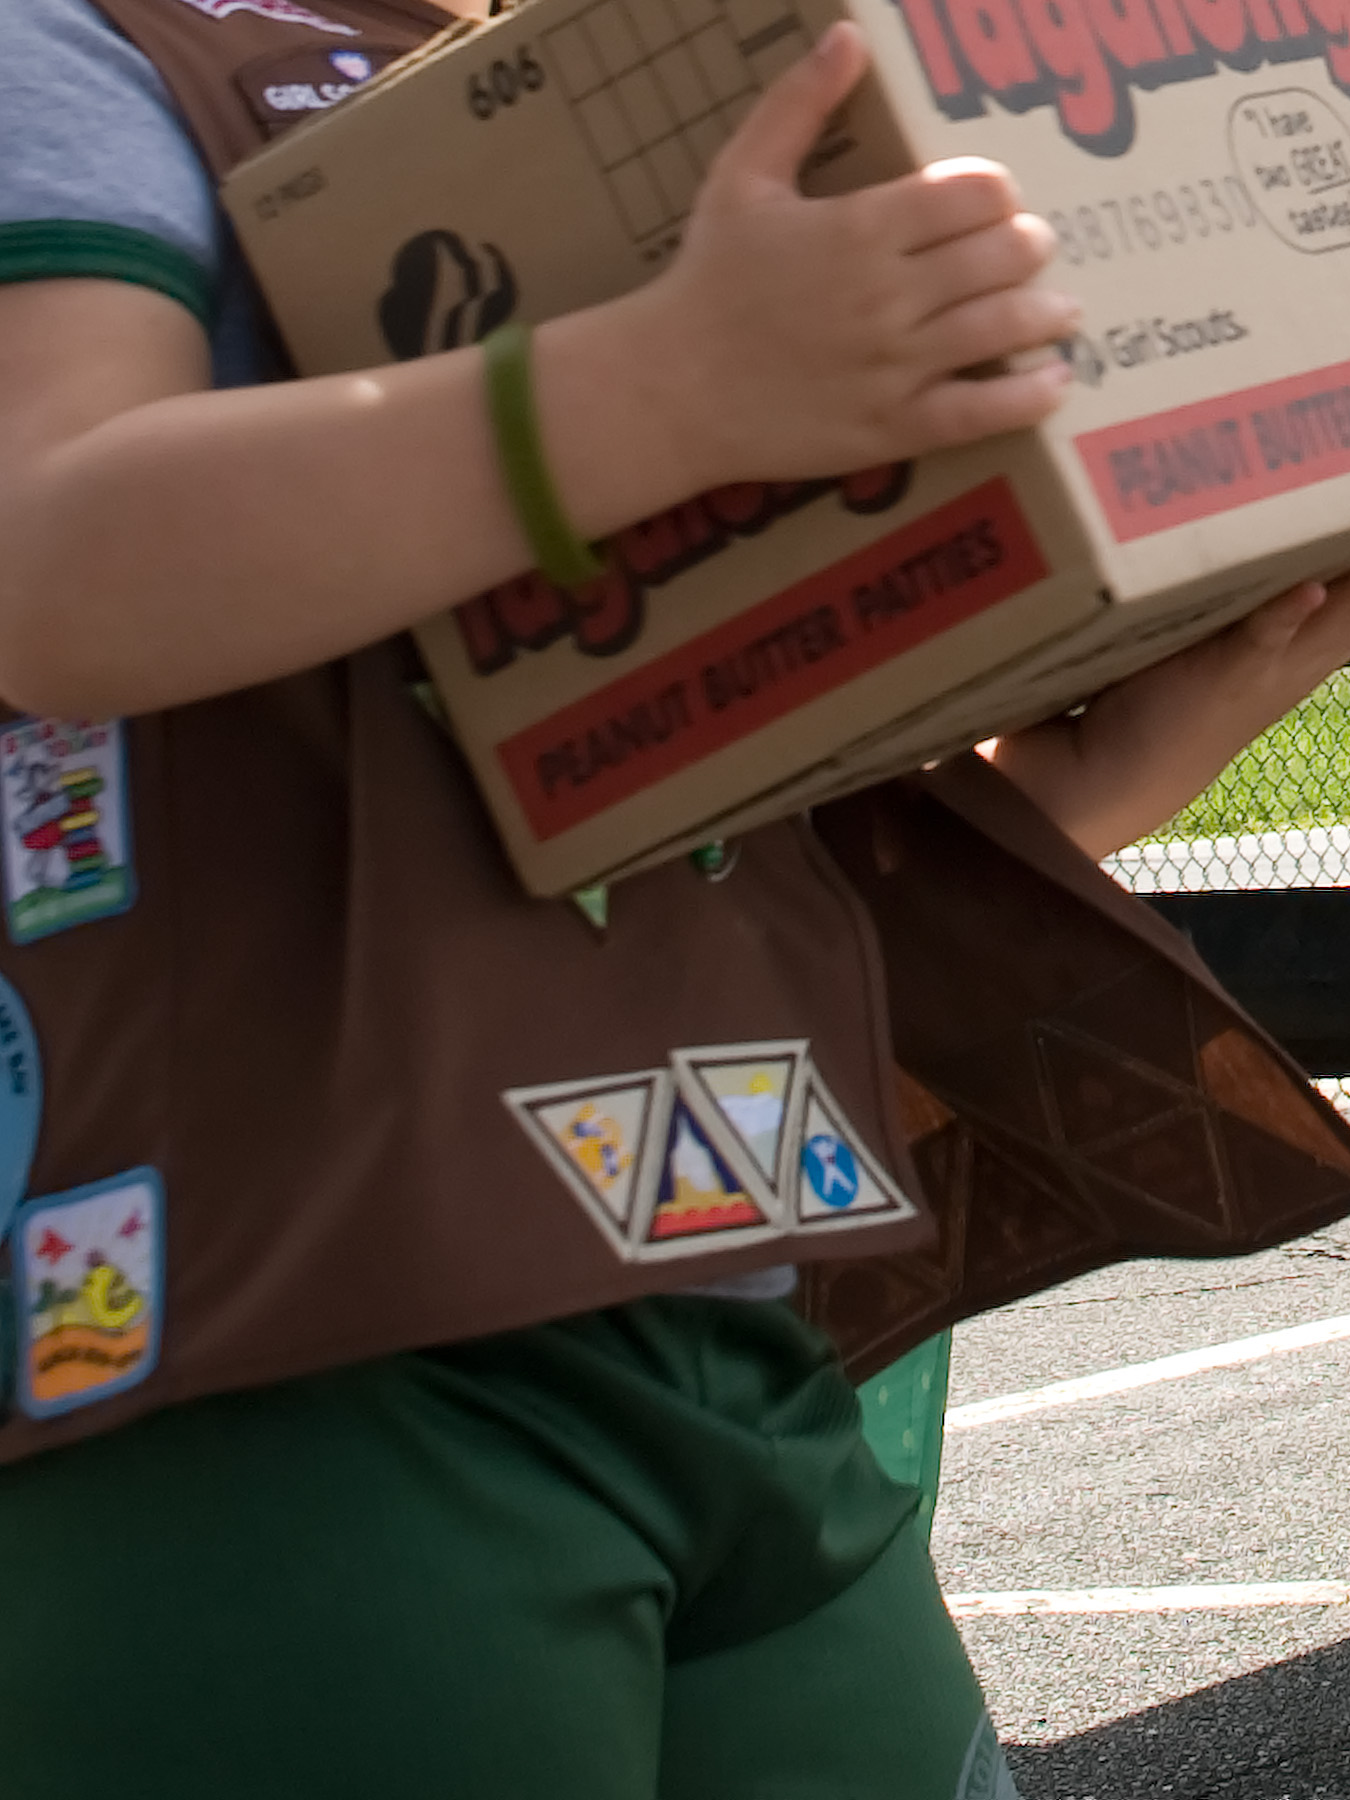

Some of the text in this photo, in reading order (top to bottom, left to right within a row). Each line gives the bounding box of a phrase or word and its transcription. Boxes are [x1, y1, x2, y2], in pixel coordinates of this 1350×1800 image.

[467, 46, 545, 120] 606
[1105, 321, 1158, 368] Girl
[1108, 418, 1252, 513] PEANUT
[534, 679, 693, 799] PEANUT
[703, 603, 846, 712] BUTTER
[853, 516, 1005, 630] PATTIES
